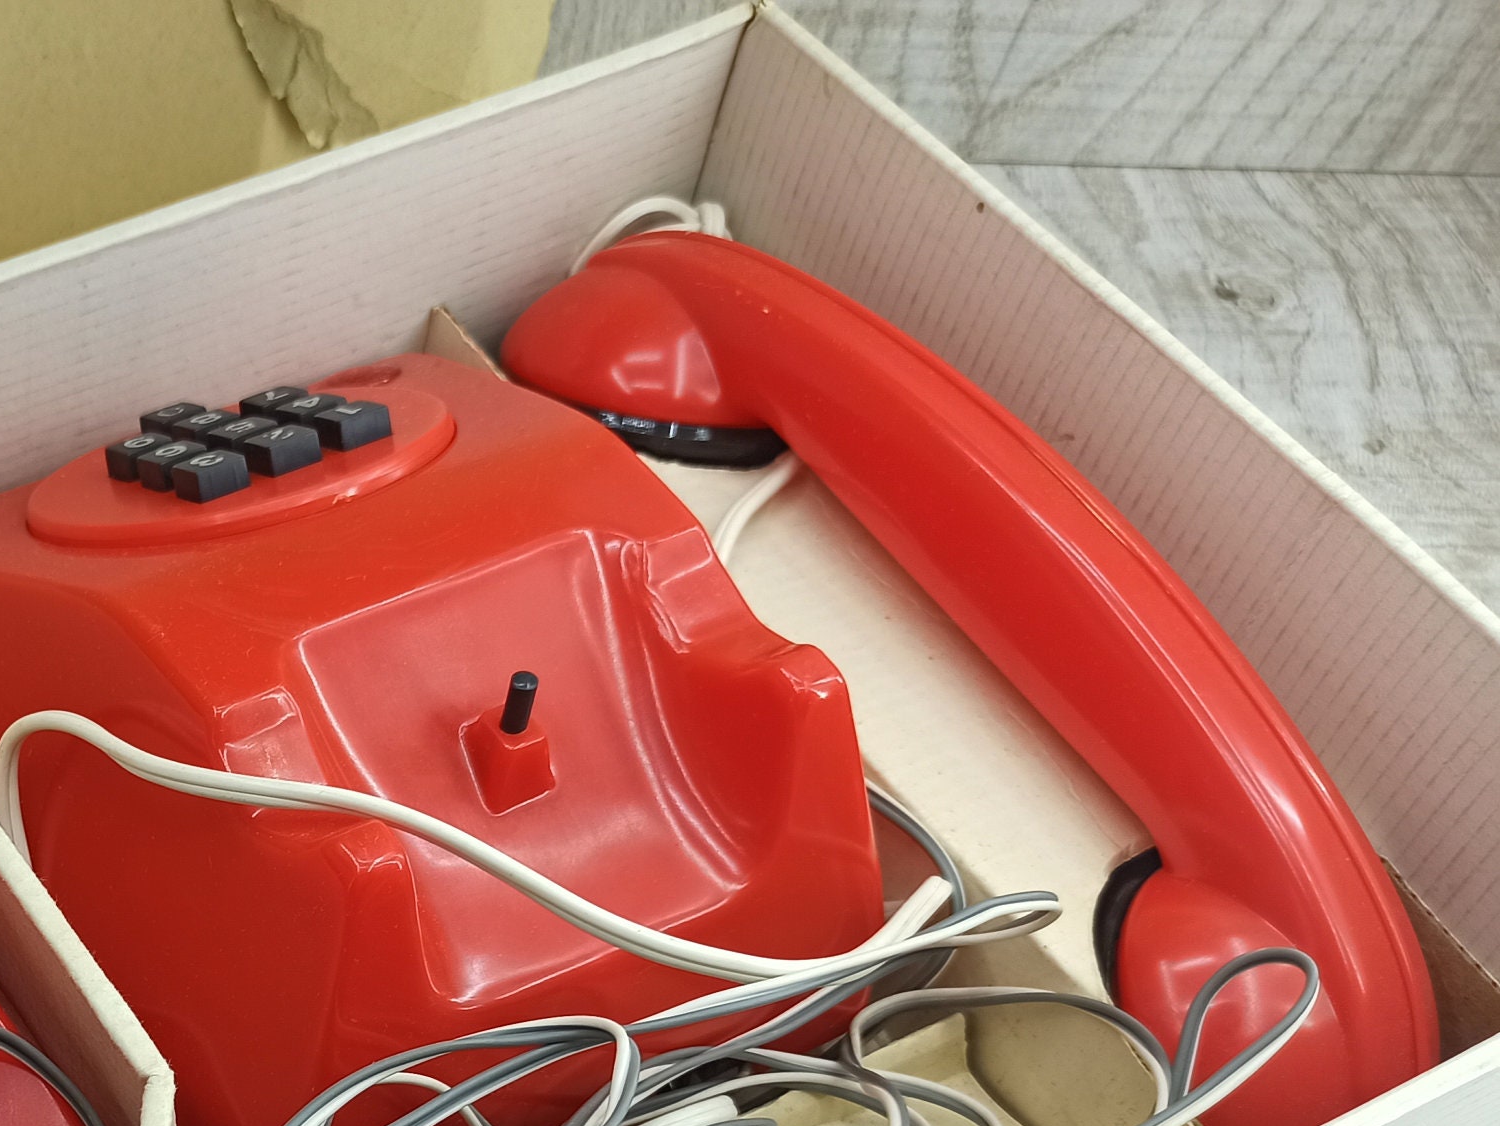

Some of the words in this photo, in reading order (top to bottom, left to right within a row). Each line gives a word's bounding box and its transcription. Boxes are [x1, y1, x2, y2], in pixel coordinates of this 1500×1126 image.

[293, 396, 320, 409] 4
[190, 412, 221, 425] 8
[225, 420, 256, 433] 5
[123, 436, 154, 449] 9
[190, 452, 223, 467] 3
